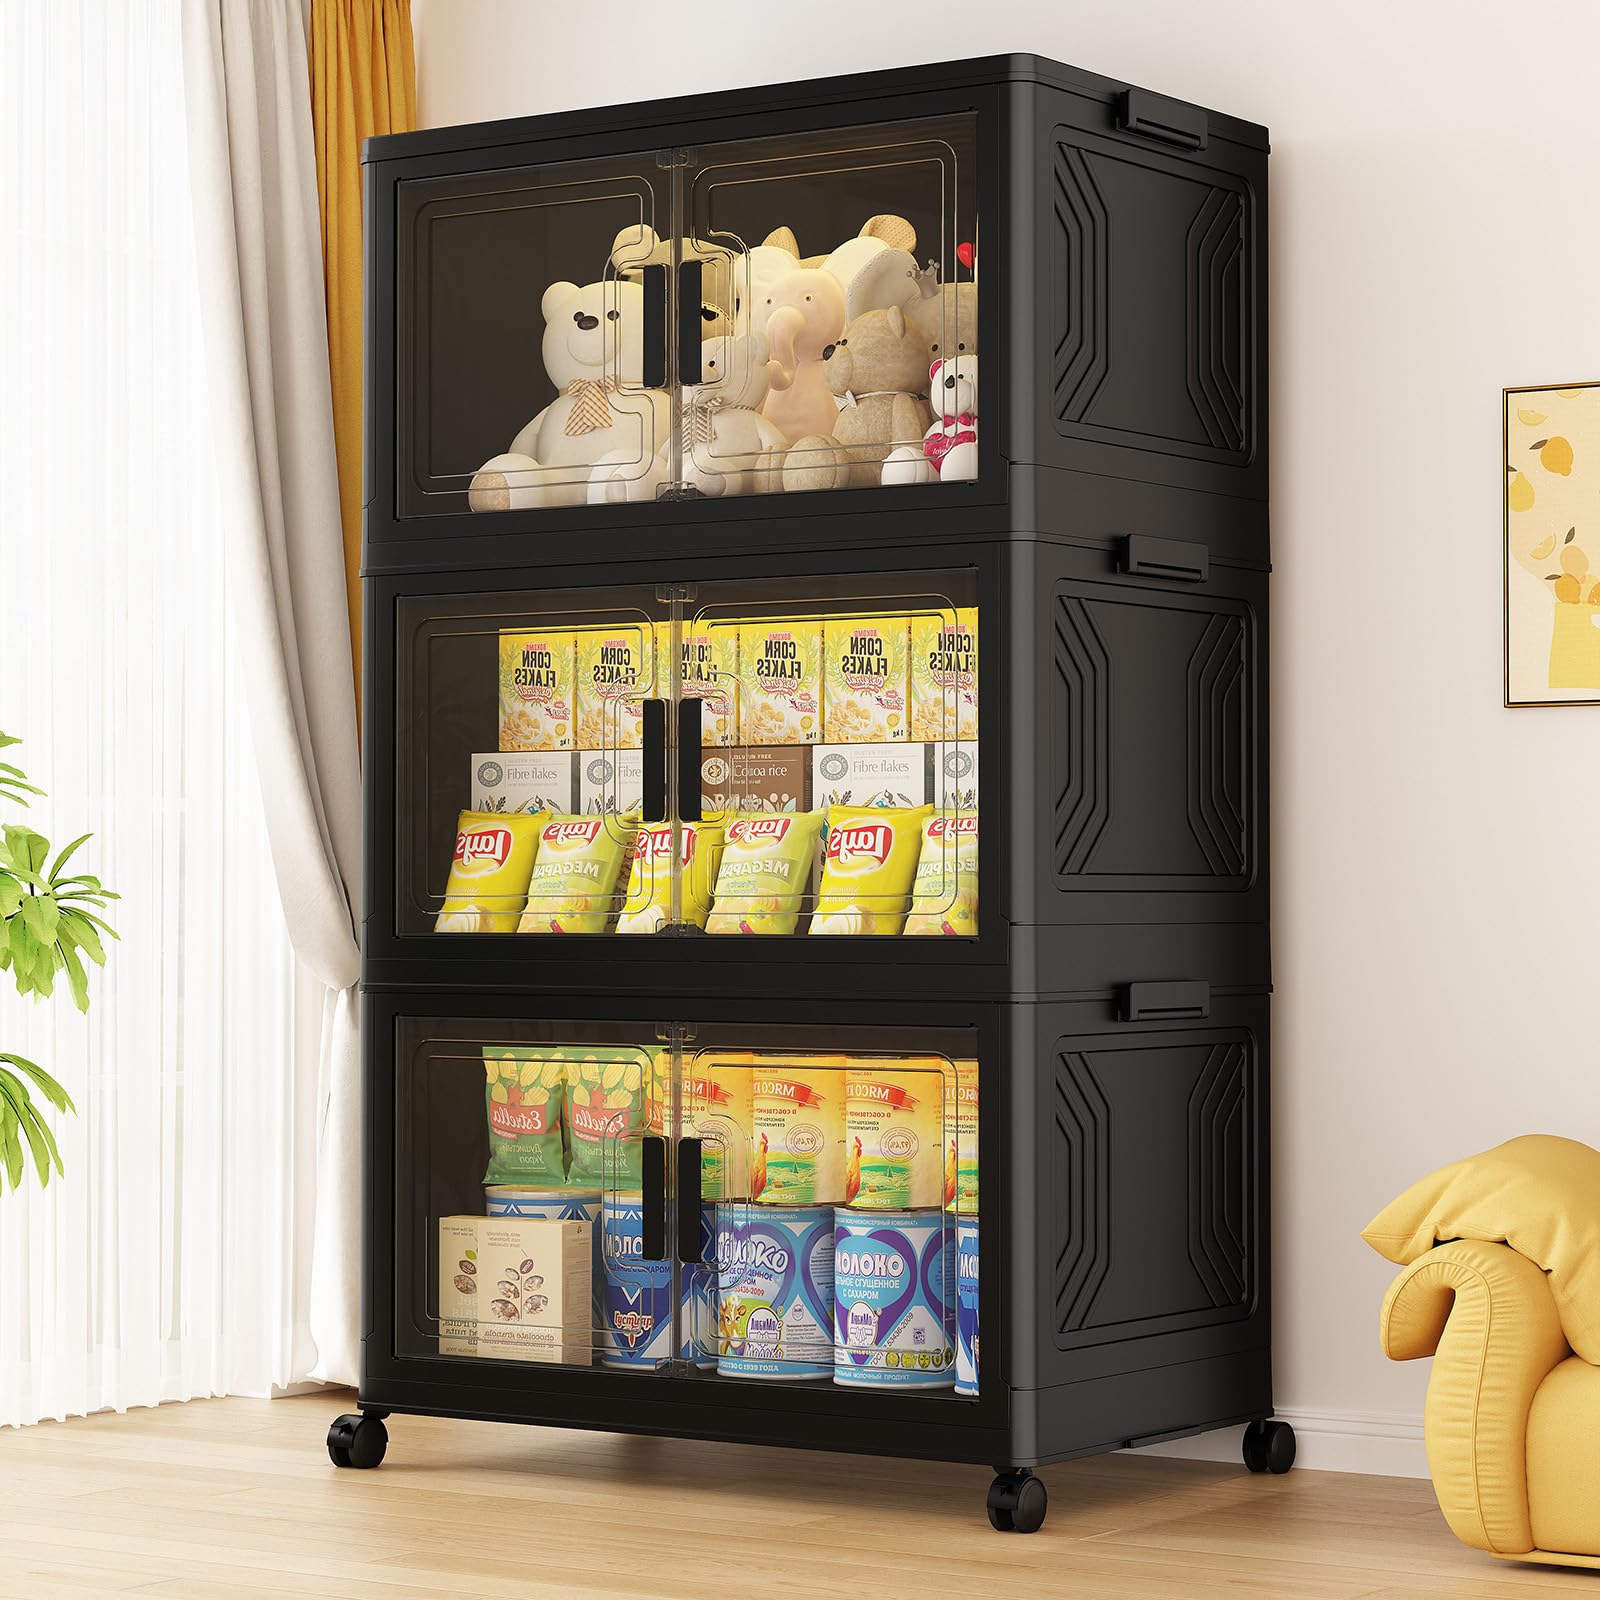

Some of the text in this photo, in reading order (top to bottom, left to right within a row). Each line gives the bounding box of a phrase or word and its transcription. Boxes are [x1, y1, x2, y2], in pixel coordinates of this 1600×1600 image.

[618, 765, 641, 778] Fibre
[768, 764, 788, 777] rice
[853, 759, 910, 773] Fibre flakes
[507, 767, 558, 780] Fibre flakes
[855, 1278, 900, 1289] СГУЩЕННОЕ
[842, 1288, 879, 1300] С САХАРОМ
[886, 1311, 914, 1348] 53436-2009
[759, 1365, 780, 1373] ГОДА
[883, 1373, 911, 1381] ПРОДУКТ
